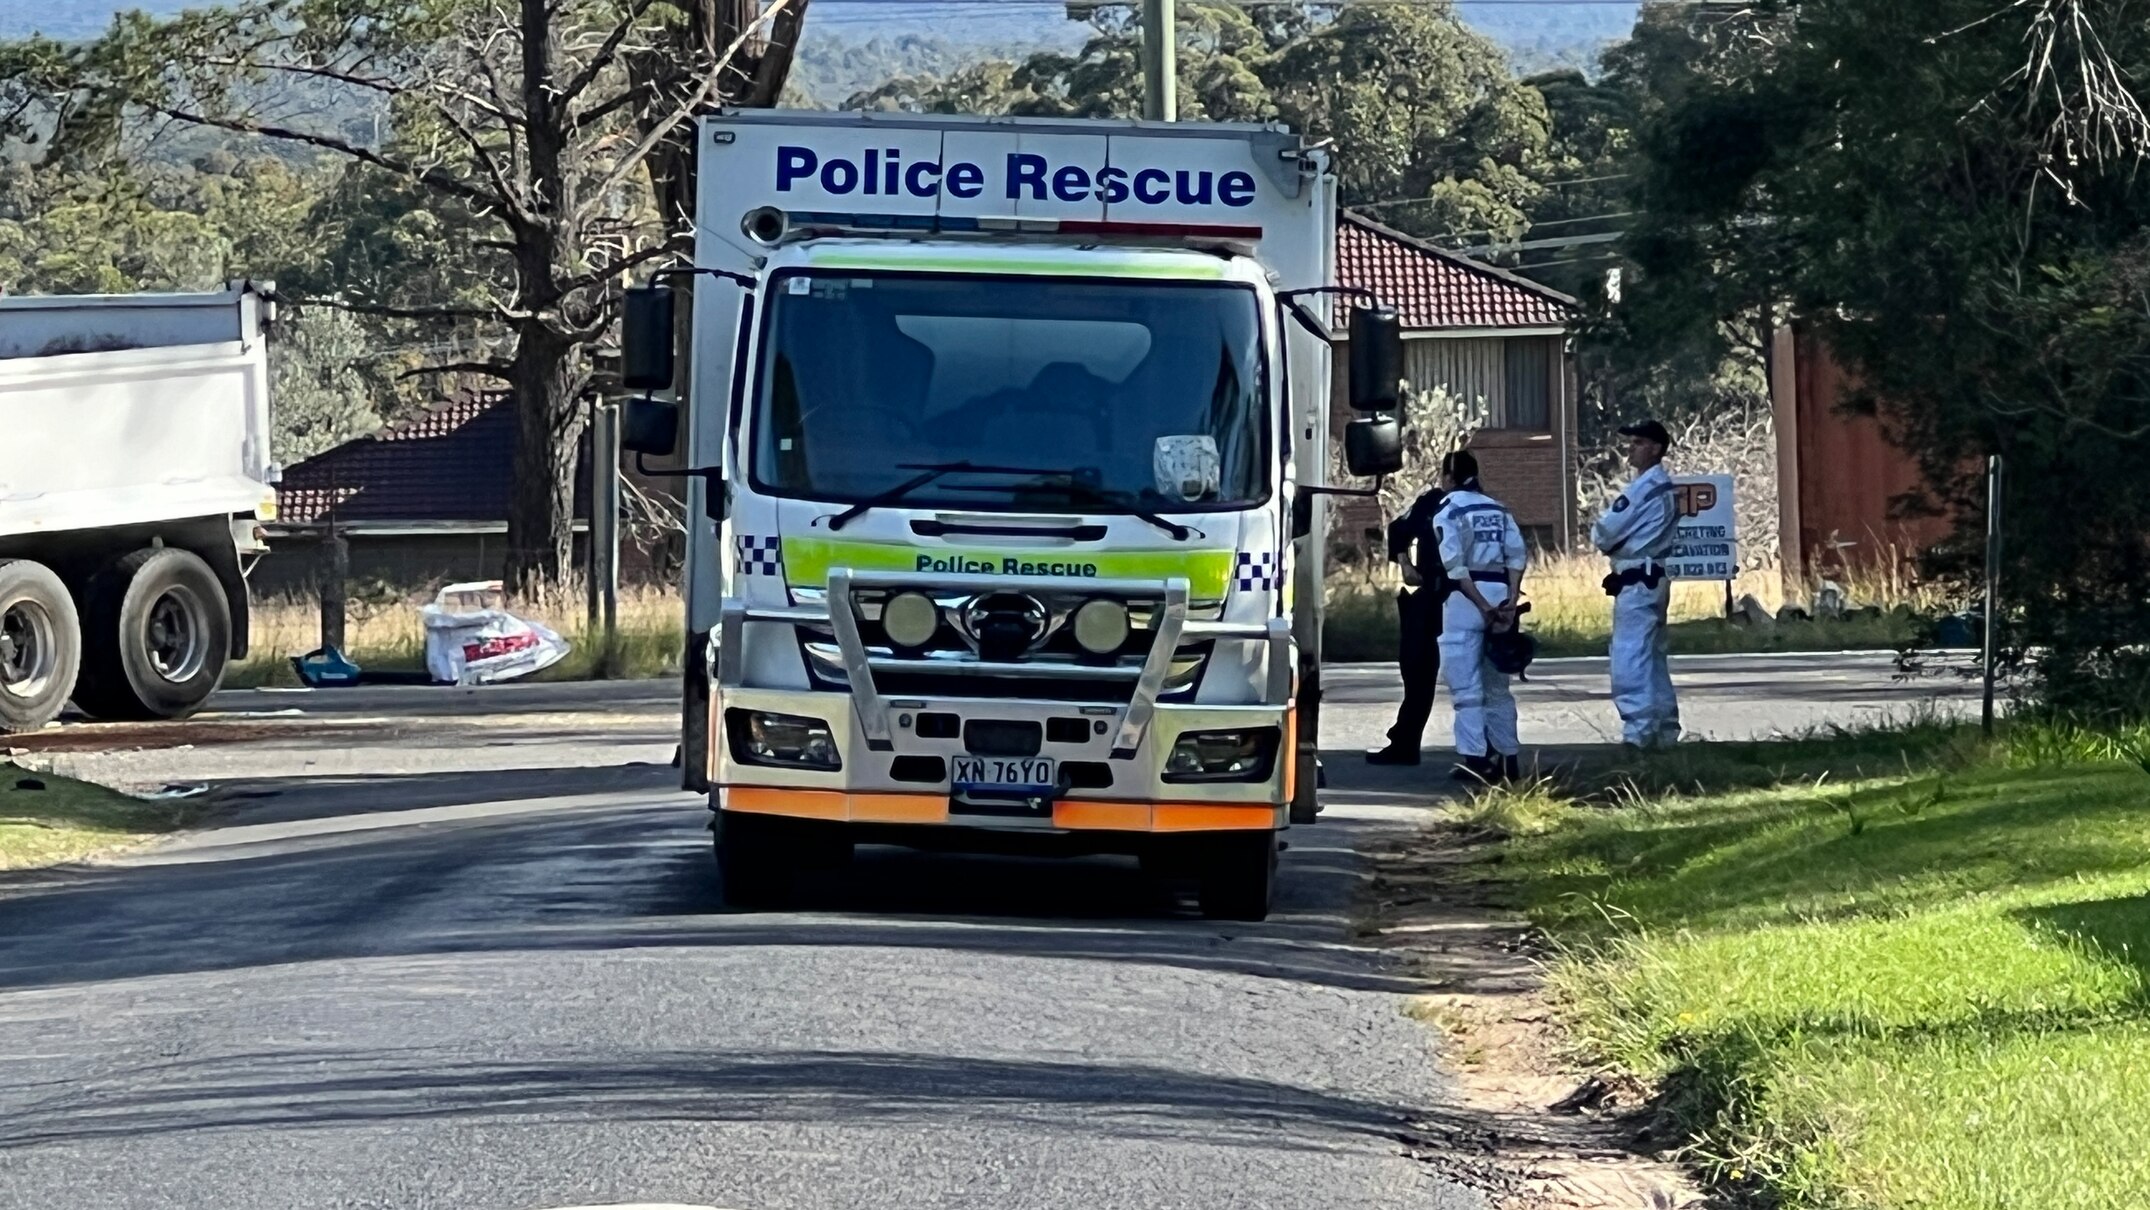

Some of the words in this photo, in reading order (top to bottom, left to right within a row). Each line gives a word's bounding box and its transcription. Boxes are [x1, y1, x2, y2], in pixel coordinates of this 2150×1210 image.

[775, 146, 985, 199] Police
[1006, 152, 1257, 207] Rescue
[916, 554, 995, 574] Police
[1003, 557, 1097, 577] Rescue
[957, 760, 985, 783] XN
